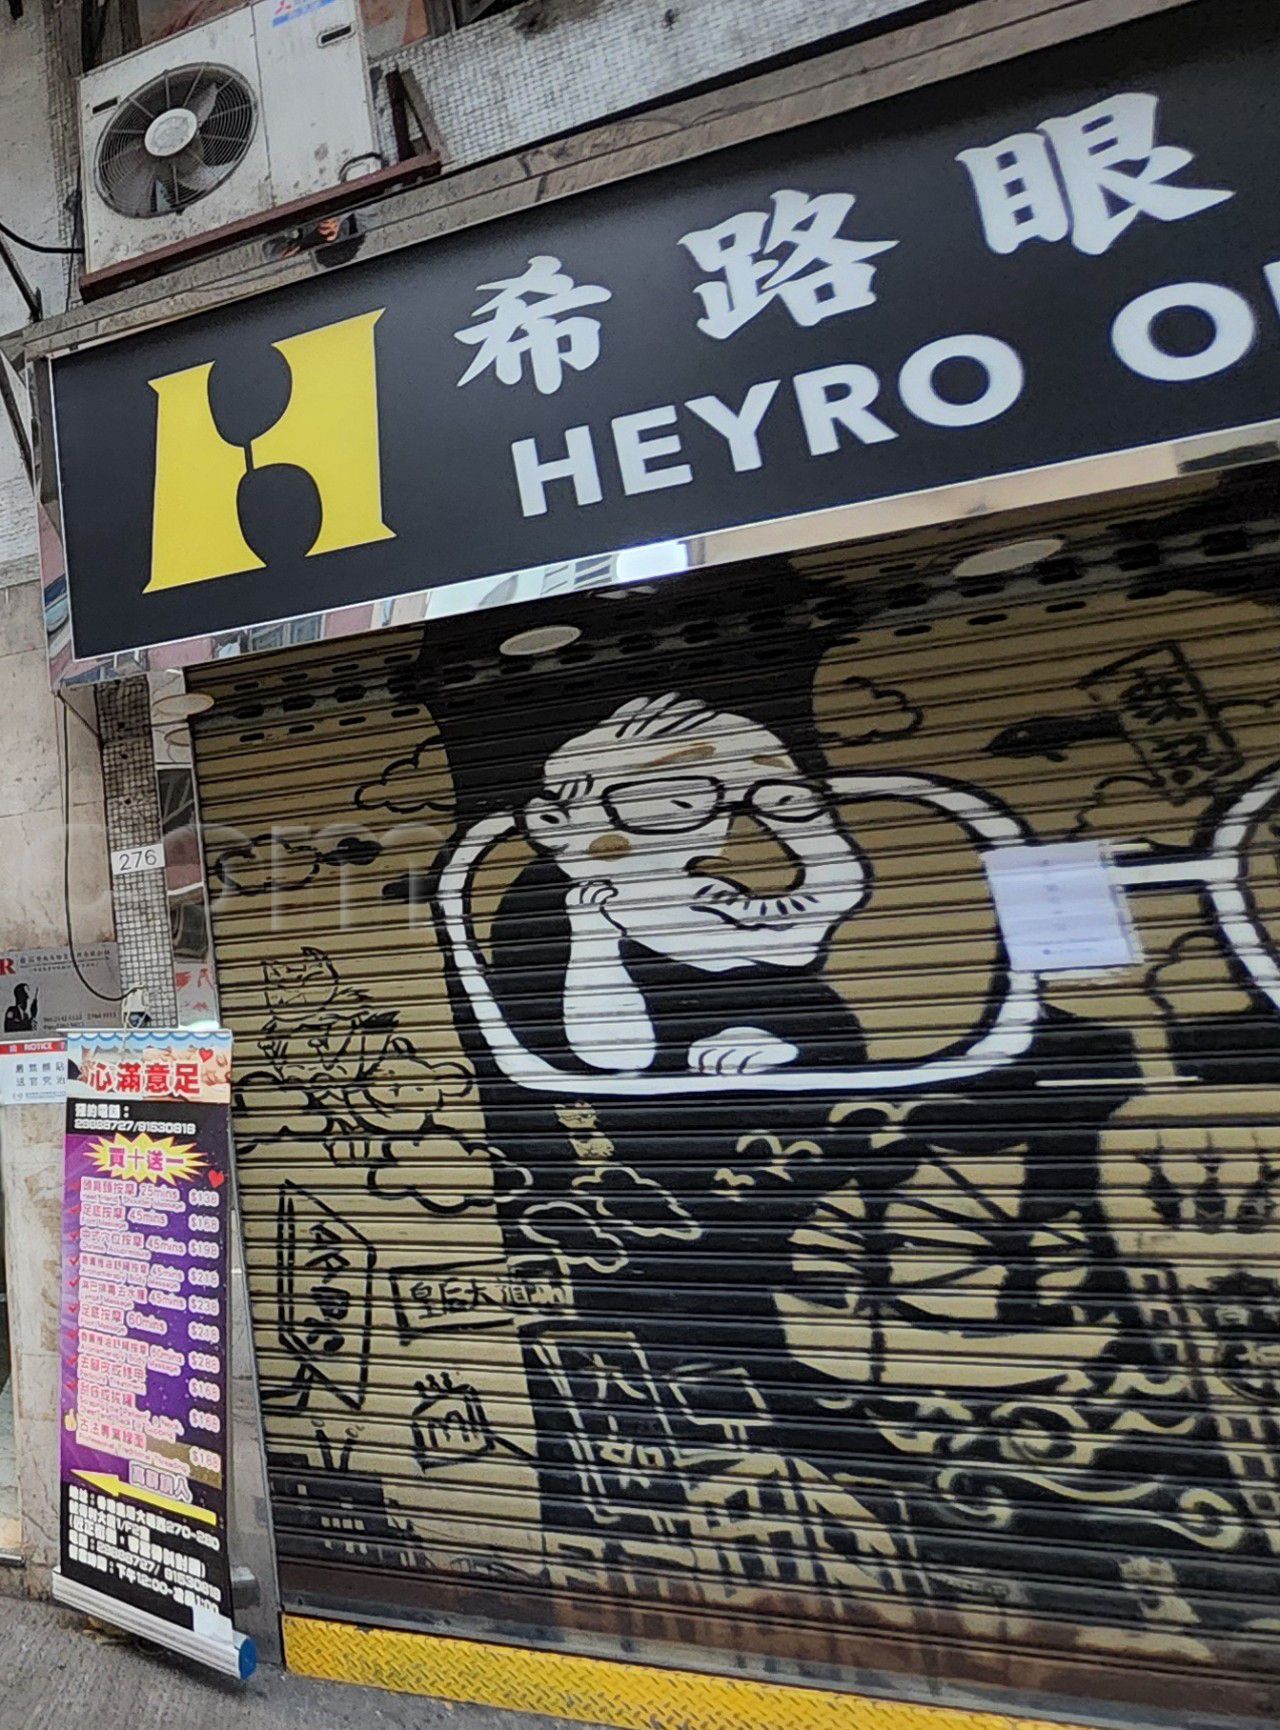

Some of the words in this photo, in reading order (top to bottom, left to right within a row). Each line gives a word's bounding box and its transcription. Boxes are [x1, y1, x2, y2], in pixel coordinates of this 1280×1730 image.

[455, 92, 1234, 396] 希路眼
[510, 334, 1024, 518] HEYRO
[1111, 258, 1280, 382] O
[119, 848, 158, 872] 276
[89, 1062, 201, 1096] 心滿意足
[109, 1146, 185, 1173] 買十送一
[129, 1209, 166, 1224] 45mins
[147, 1238, 184, 1254] 45mins
[127, 1312, 165, 1332] 60mins
